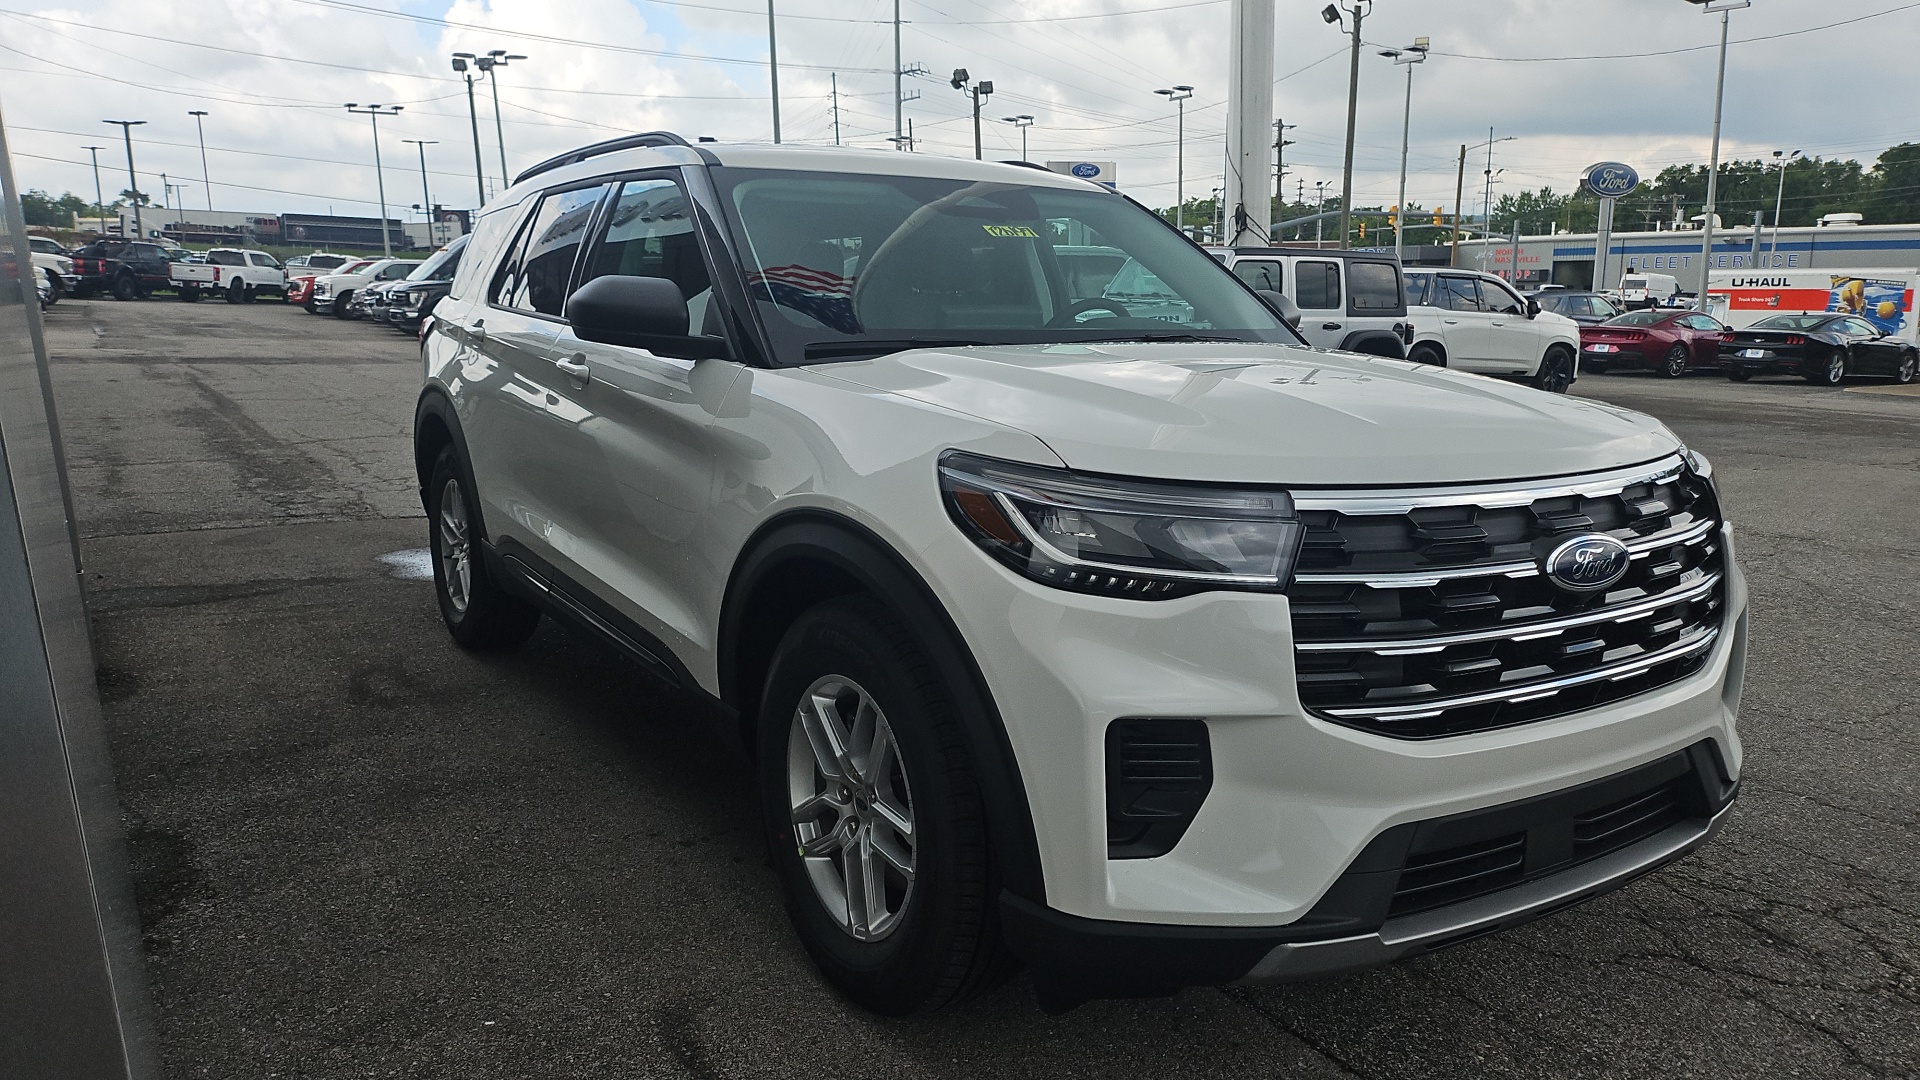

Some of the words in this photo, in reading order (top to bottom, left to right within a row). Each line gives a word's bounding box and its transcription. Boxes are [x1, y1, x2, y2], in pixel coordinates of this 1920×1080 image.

[1599, 168, 1631, 190] Ford
[1494, 256, 1541, 264] NASVILLE
[1629, 256, 1692, 269] FLEET
[1731, 277, 1791, 287] U-HAUL
[1572, 546, 1616, 580] Ford
